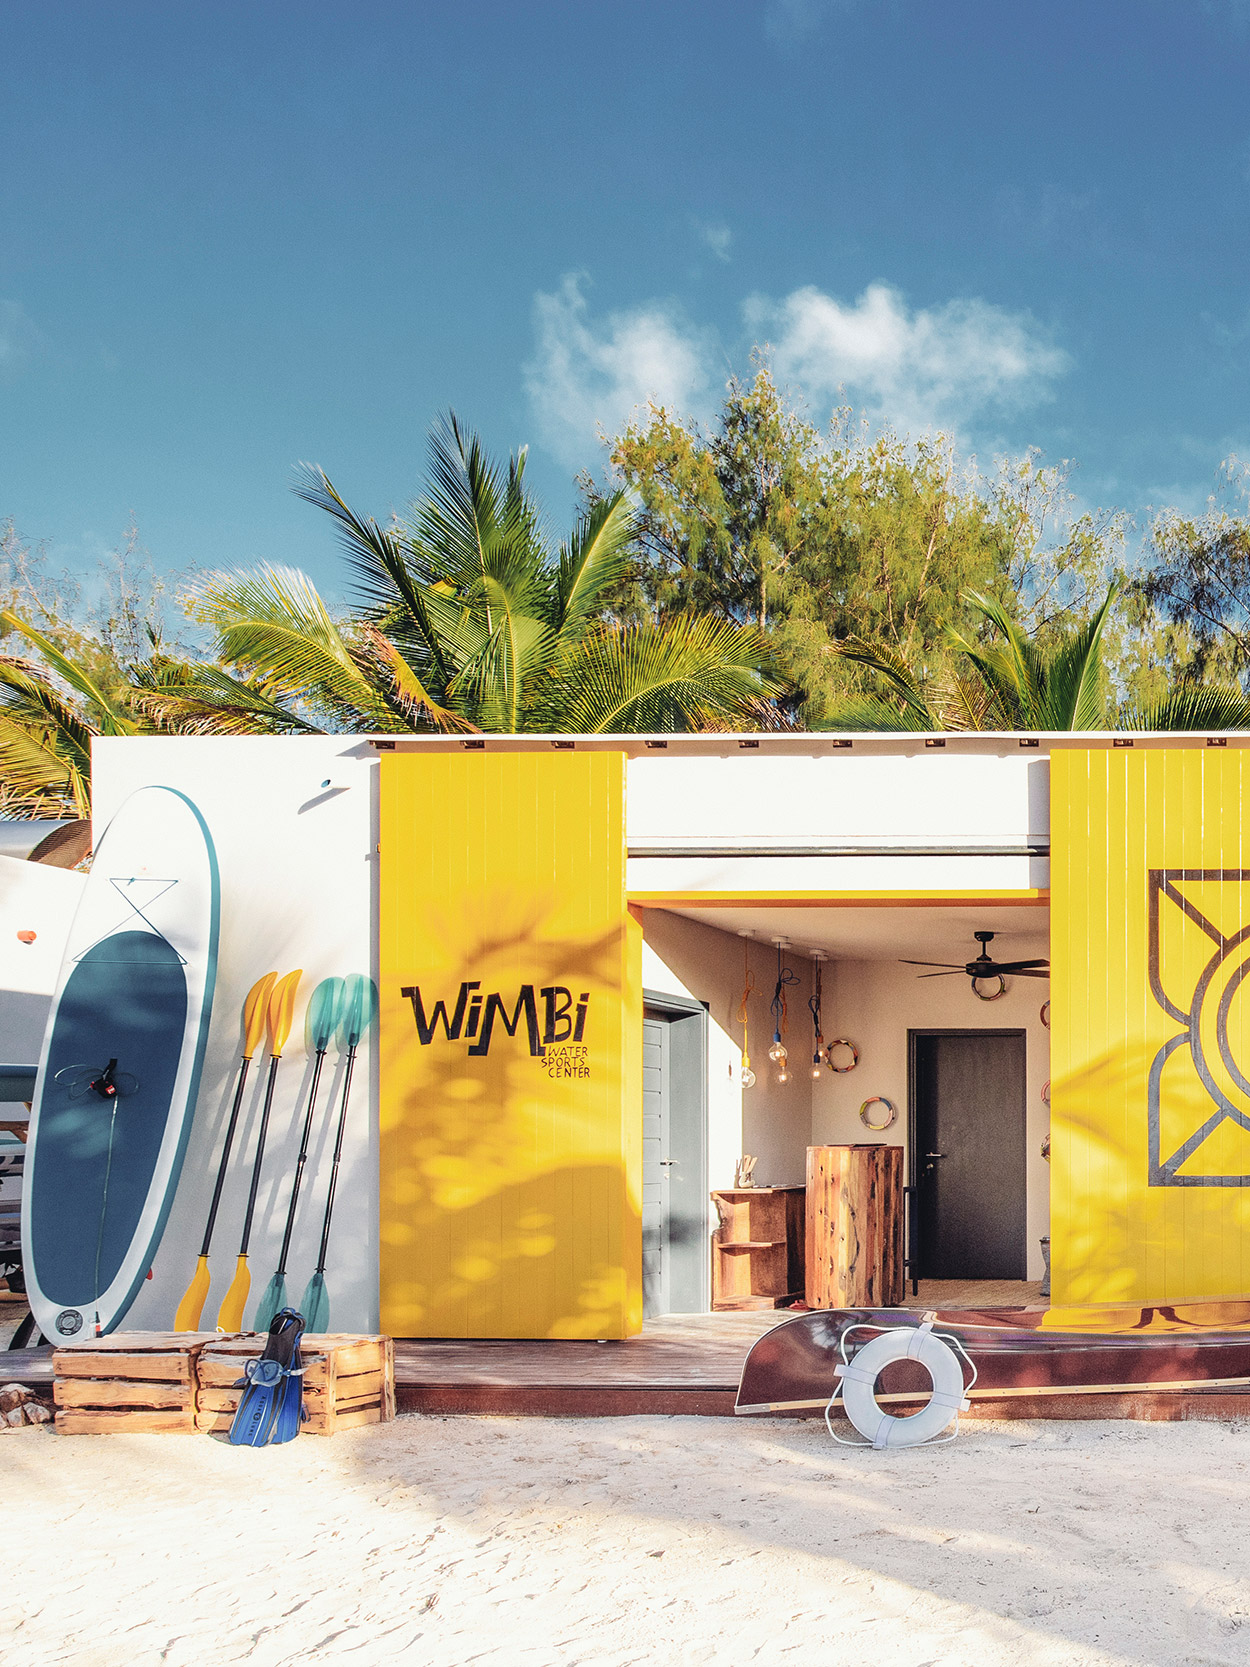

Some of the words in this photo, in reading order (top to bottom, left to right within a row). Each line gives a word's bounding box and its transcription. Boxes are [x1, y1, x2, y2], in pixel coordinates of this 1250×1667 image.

[548, 1045, 589, 1057] WATER
[541, 1056, 585, 1068] SPORTS
[548, 1067, 591, 1078] CENTER
